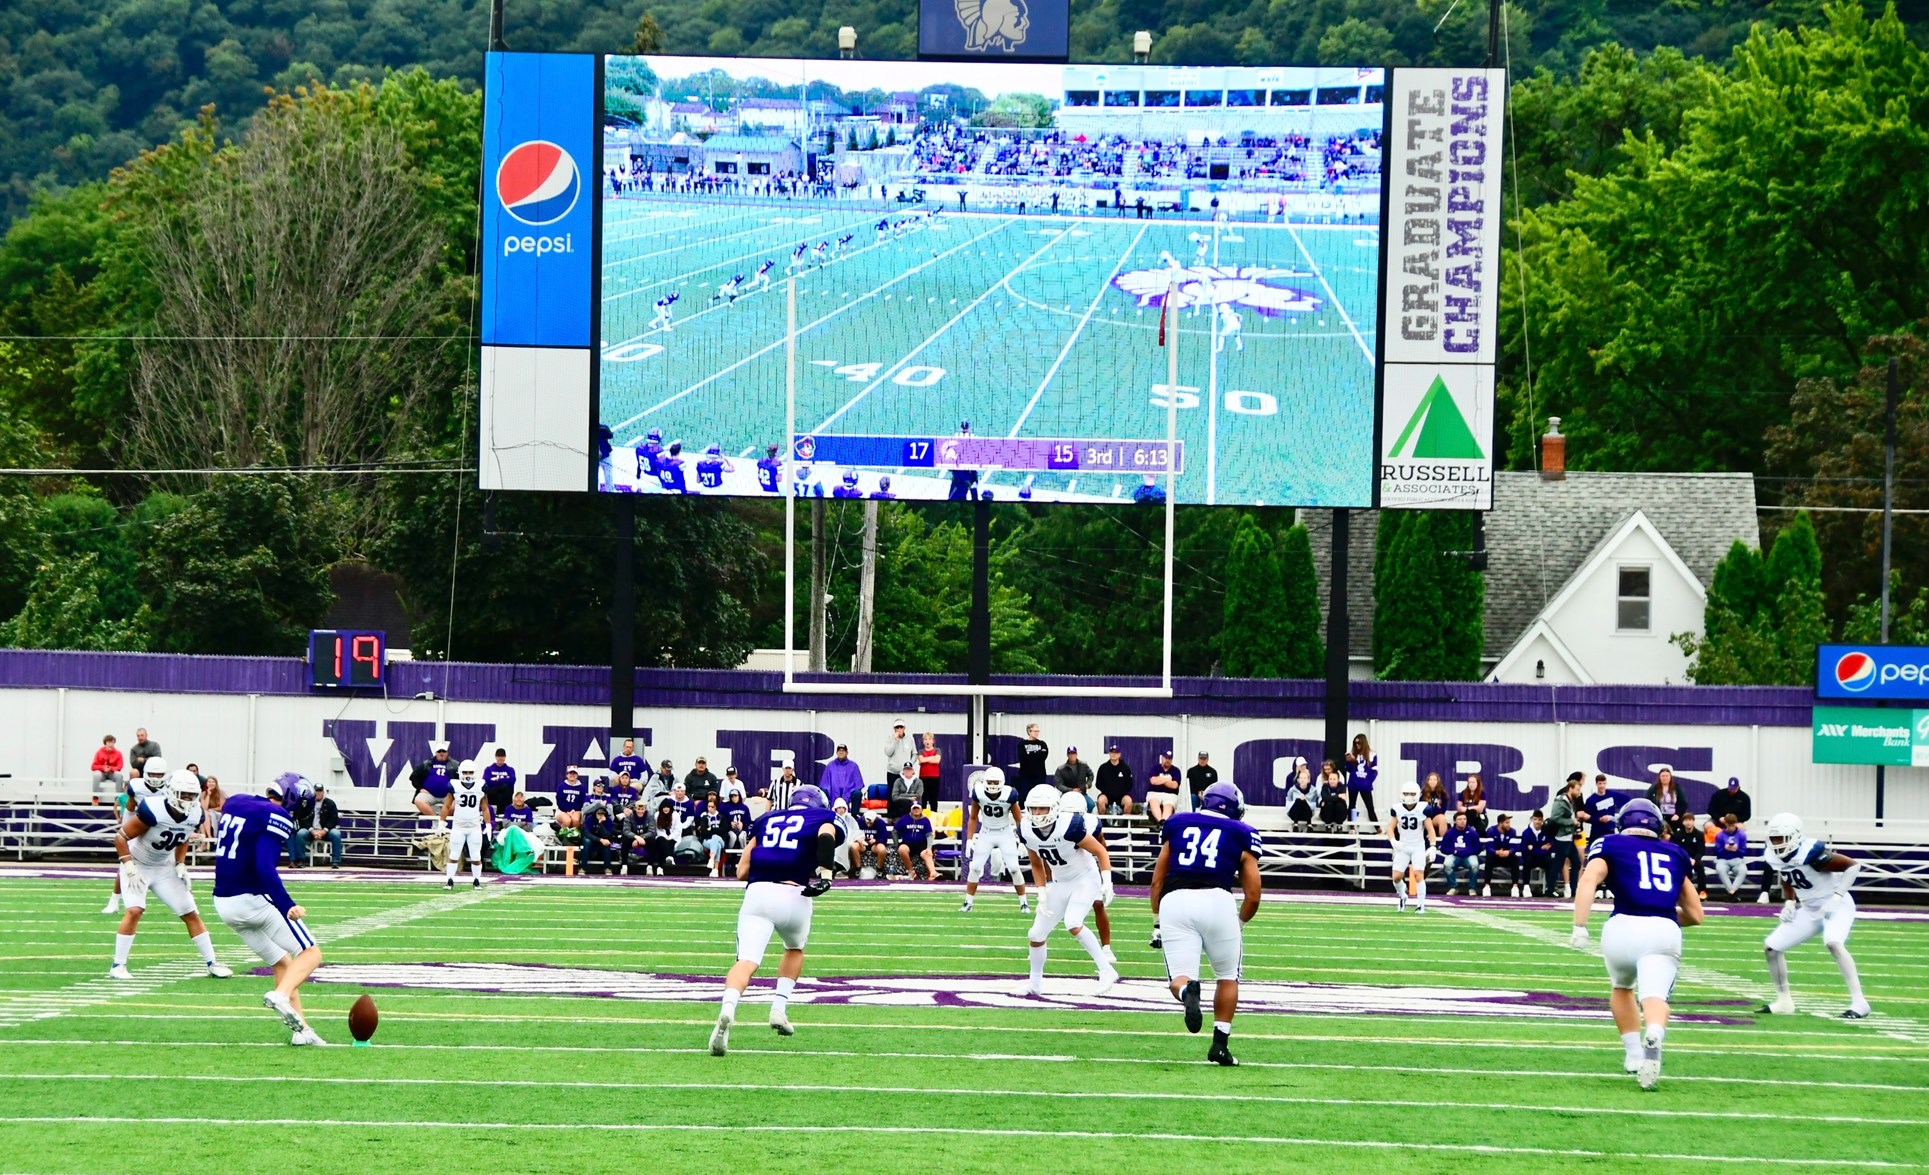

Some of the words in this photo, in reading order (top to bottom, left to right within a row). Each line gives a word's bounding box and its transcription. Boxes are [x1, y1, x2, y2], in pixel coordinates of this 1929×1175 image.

[1401, 89, 1445, 341] GRADUATE
[1443, 76, 1488, 353] CHAMPIONS
[504, 233, 571, 257] pepsi
[909, 442, 929, 460] 17
[1054, 445, 1073, 463] 15
[1087, 448, 1112, 465] 3rd
[1134, 449, 1168, 466] 6:13
[701, 473, 715, 486] 37
[1381, 464, 1490, 482] RUSSELL
[1383, 483, 1391, 493] &
[334, 635, 379, 679] 19
[1851, 725, 1910, 738] Merchants
[1883, 737, 1911, 747] Bank
[459, 794, 477, 808] 30
[762, 815, 805, 849] 52
[1401, 816, 1418, 831] 33
[151, 830, 187, 852] 36
[216, 813, 246, 859] 27
[1178, 826, 1222, 868] 34
[1637, 850, 1673, 892] 15
